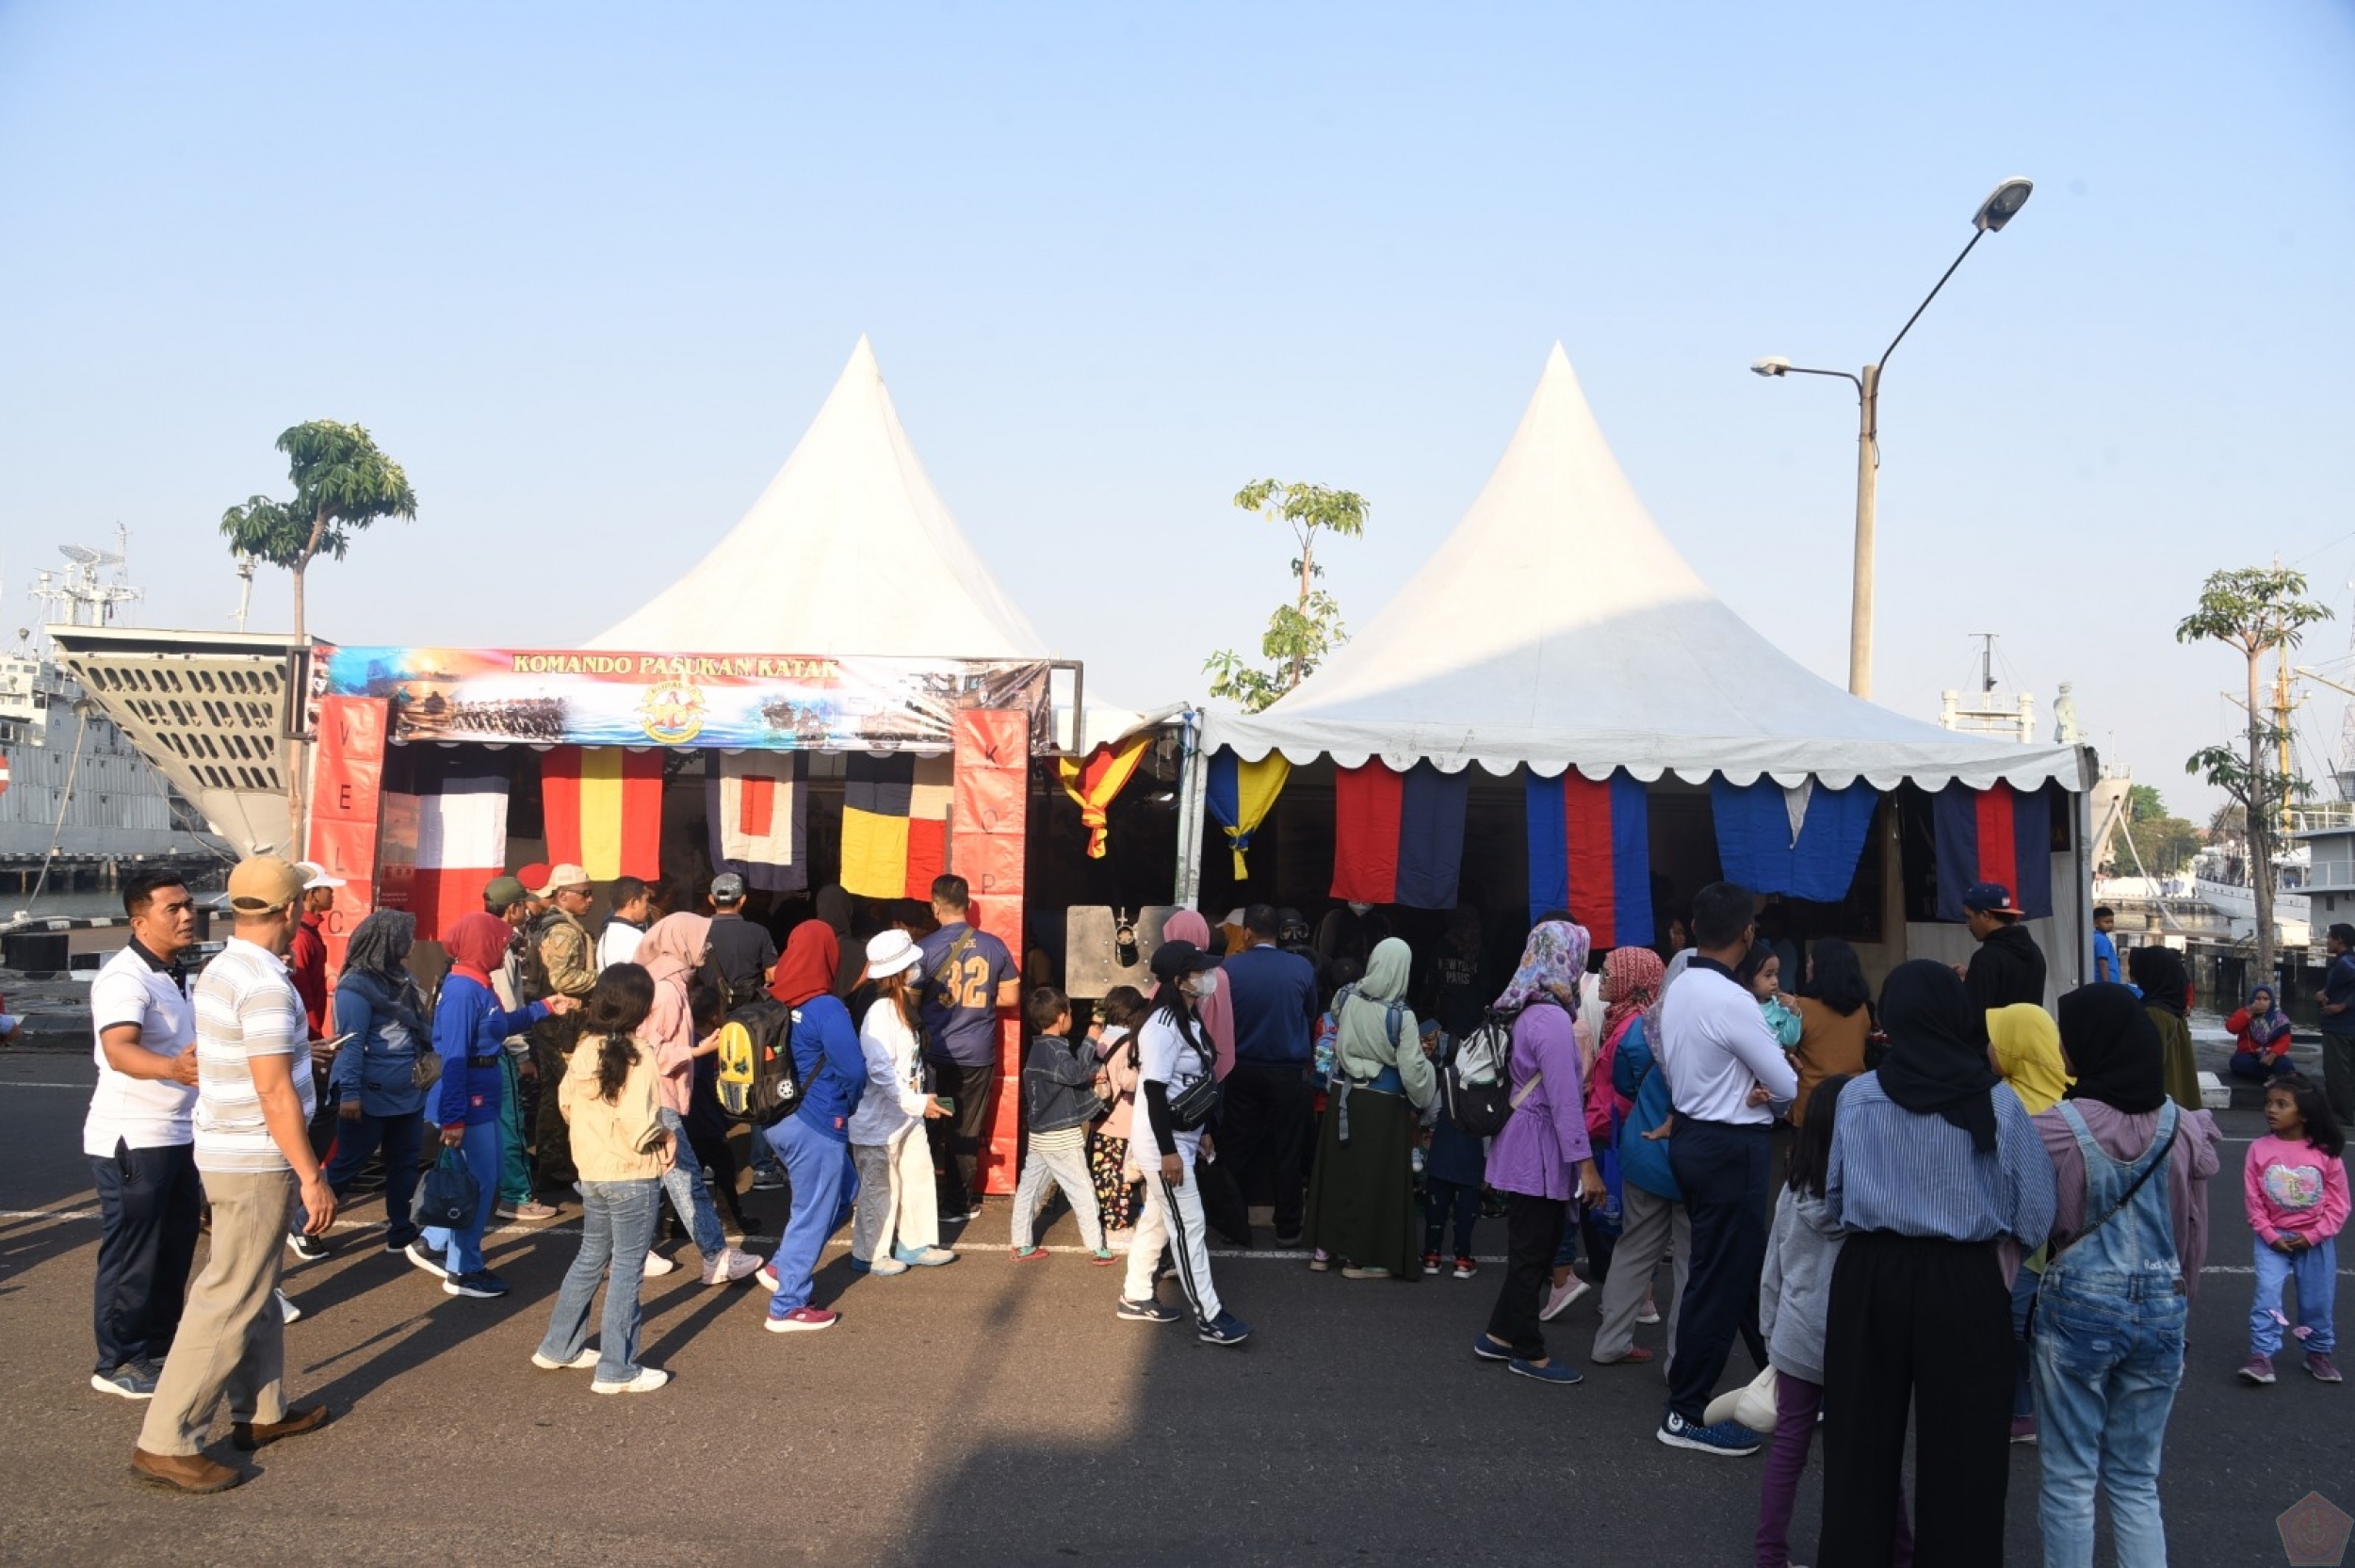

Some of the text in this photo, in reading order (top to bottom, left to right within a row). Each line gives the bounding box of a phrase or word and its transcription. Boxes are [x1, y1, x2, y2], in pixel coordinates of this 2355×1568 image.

[512, 655, 839, 678] KOMANDO PASUKAN KATAK
[938, 955, 990, 1009] 32
